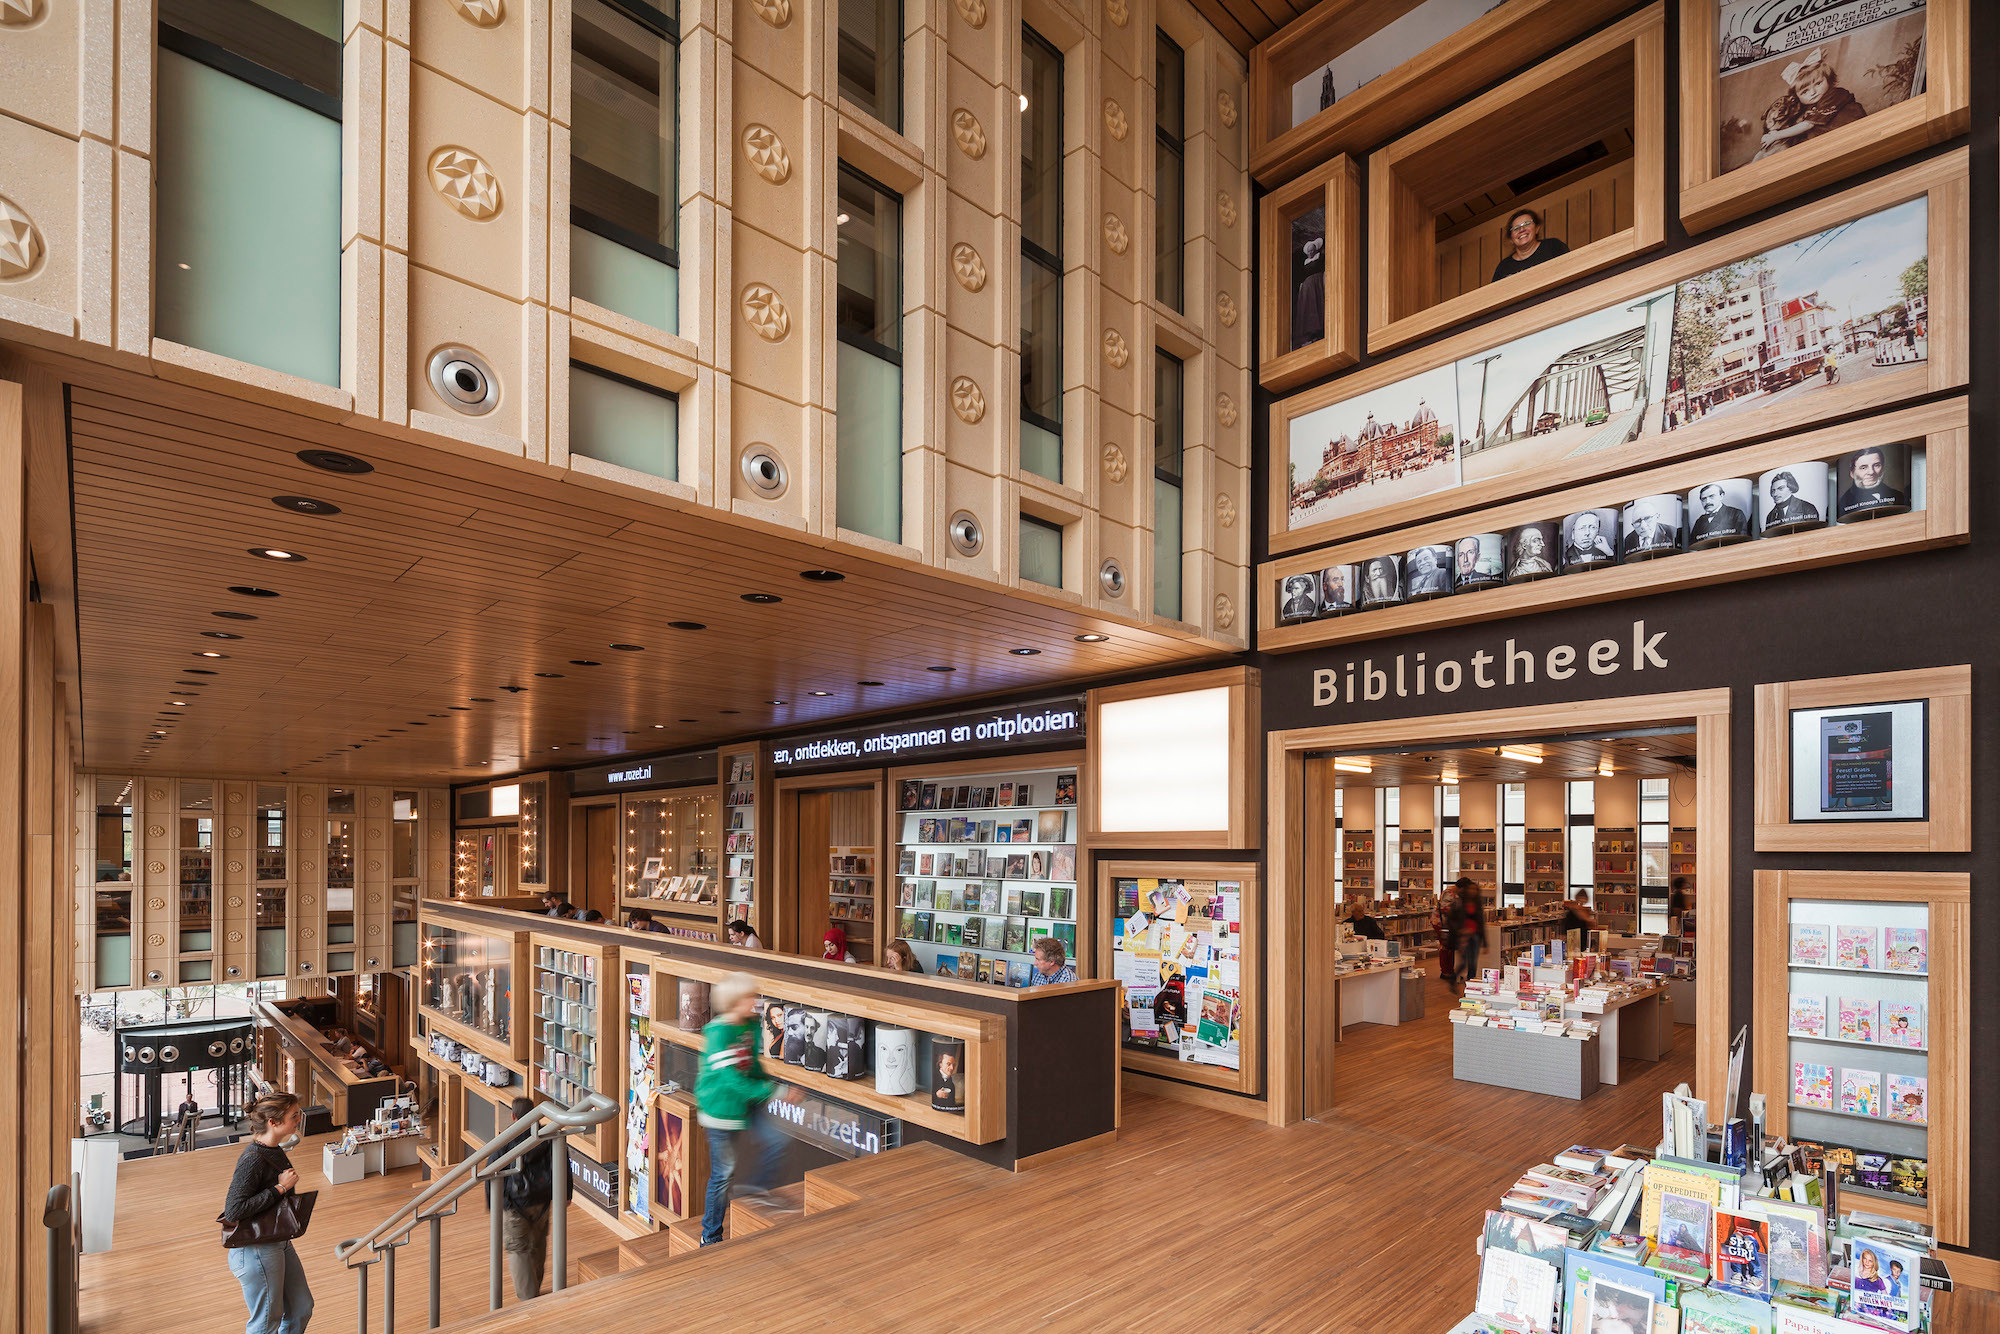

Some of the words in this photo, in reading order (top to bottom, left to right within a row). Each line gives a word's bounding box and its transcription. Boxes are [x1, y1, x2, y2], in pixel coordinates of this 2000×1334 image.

[1785, 31, 1830, 49] FAMILIE
[1834, 7, 1897, 32] WEEKBLAD
[1787, 30, 1797, 38] IN
[1798, 13, 1840, 32] WOORD
[1843, 10, 1857, 19] EN
[1313, 620, 1669, 707] Bibliotheek
[795, 738, 861, 761] ontdekken,
[863, 727, 946, 753] ontspannen
[951, 726, 971, 742] en
[607, 765, 652, 783] www.rozet.nl
[583, 1163, 591, 1184] in
[593, 1170, 610, 1198] Roz
[1863, 1174, 1888, 1182] 365
[1899, 1180, 1924, 1188] 365
[1653, 1183, 1664, 1191] OP
[1664, 1184, 1708, 1200] EXPEDITIE!
[1729, 1236, 1754, 1250] SPY
[1784, 1318, 1810, 1332] Papa
